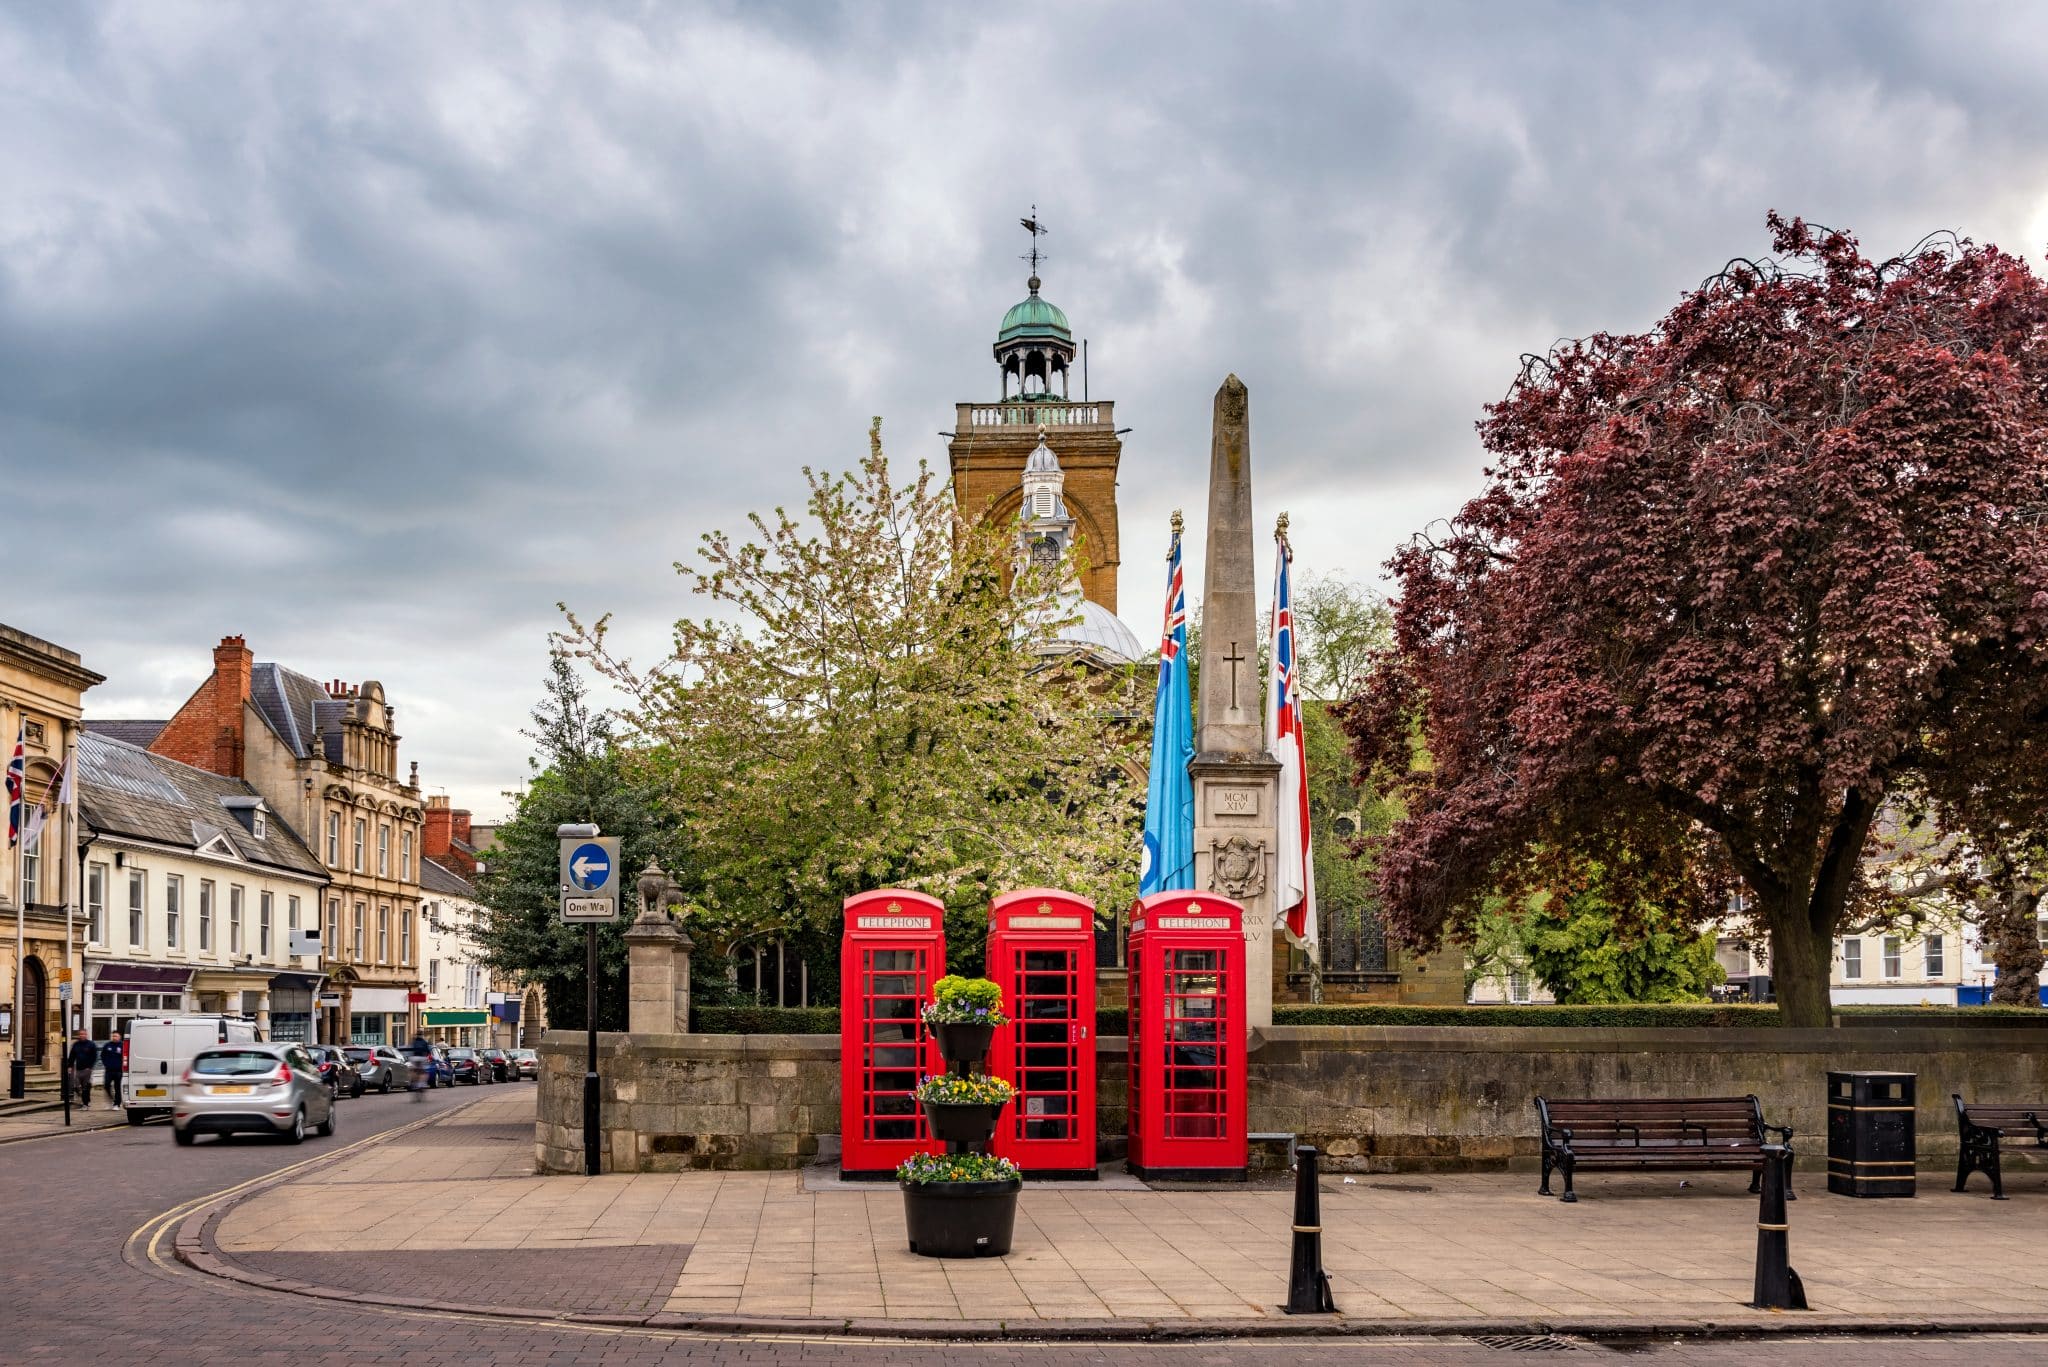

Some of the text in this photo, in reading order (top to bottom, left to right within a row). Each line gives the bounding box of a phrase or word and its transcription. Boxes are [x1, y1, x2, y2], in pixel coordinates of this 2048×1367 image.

[1224, 793, 1248, 802] MCM
[1226, 802, 1246, 811] XIV
[569, 902, 609, 913] One Way
[861, 917, 928, 928] TELEPHONE
[1162, 918, 1227, 928] TELEPHONE
